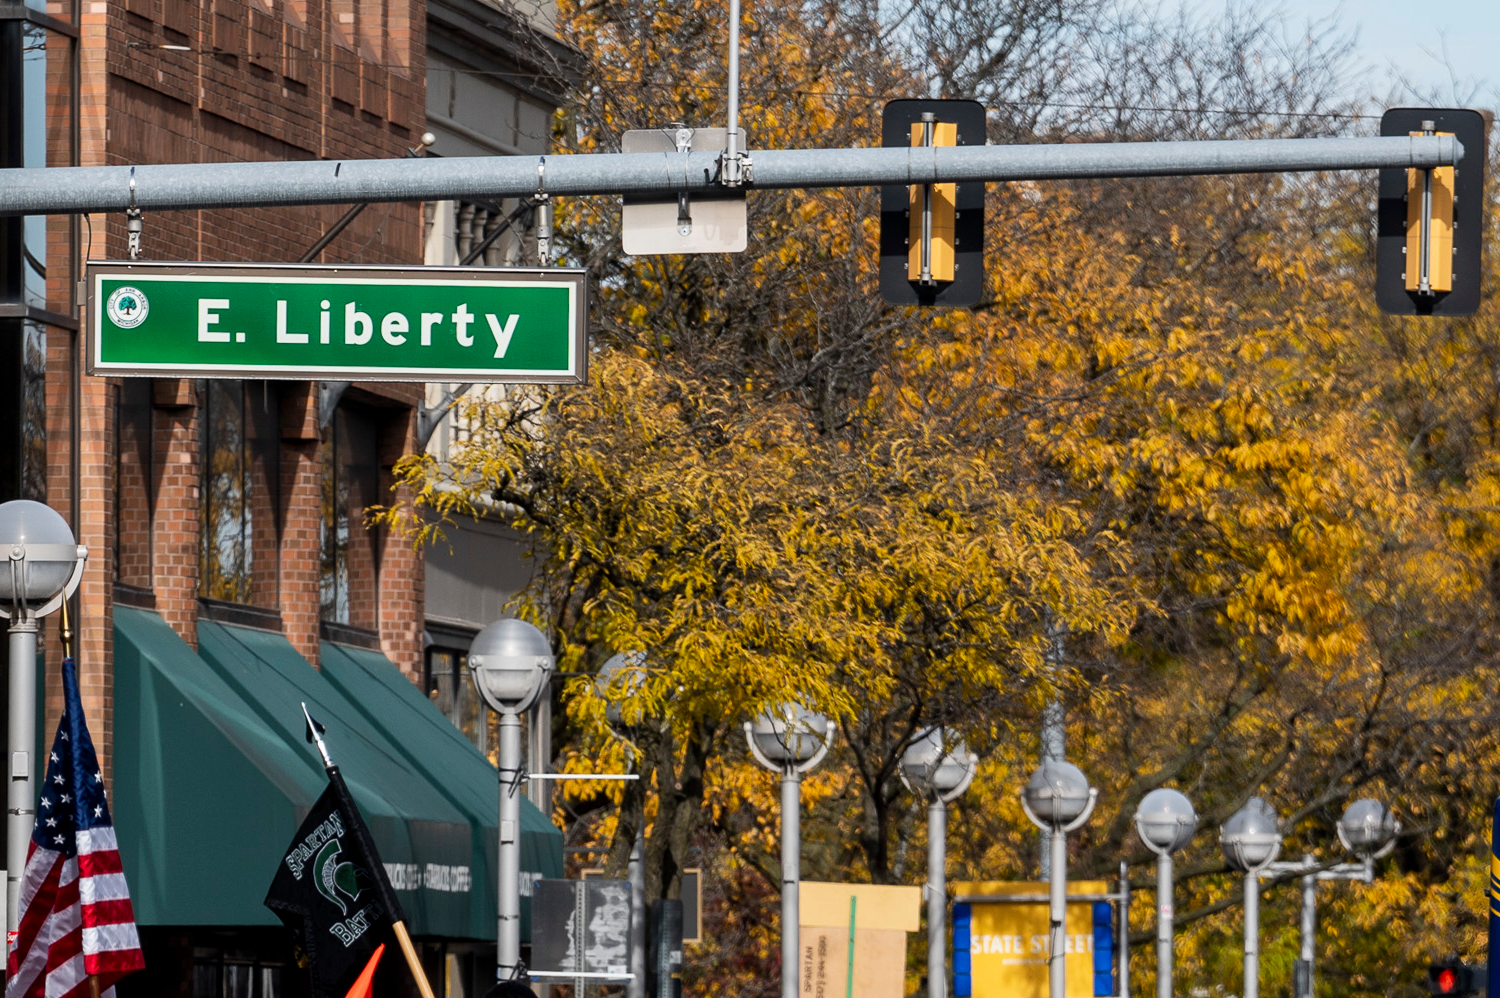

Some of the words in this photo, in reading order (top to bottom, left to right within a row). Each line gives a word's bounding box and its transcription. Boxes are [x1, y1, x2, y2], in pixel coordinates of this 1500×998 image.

[198, 298, 246, 343] E.
[276, 299, 520, 359] Liberty
[285, 809, 347, 881] SPARTAN
[804, 945, 813, 993] SPARTAN
[971, 934, 1023, 955] STATE
[1030, 934, 1095, 954] STEET
